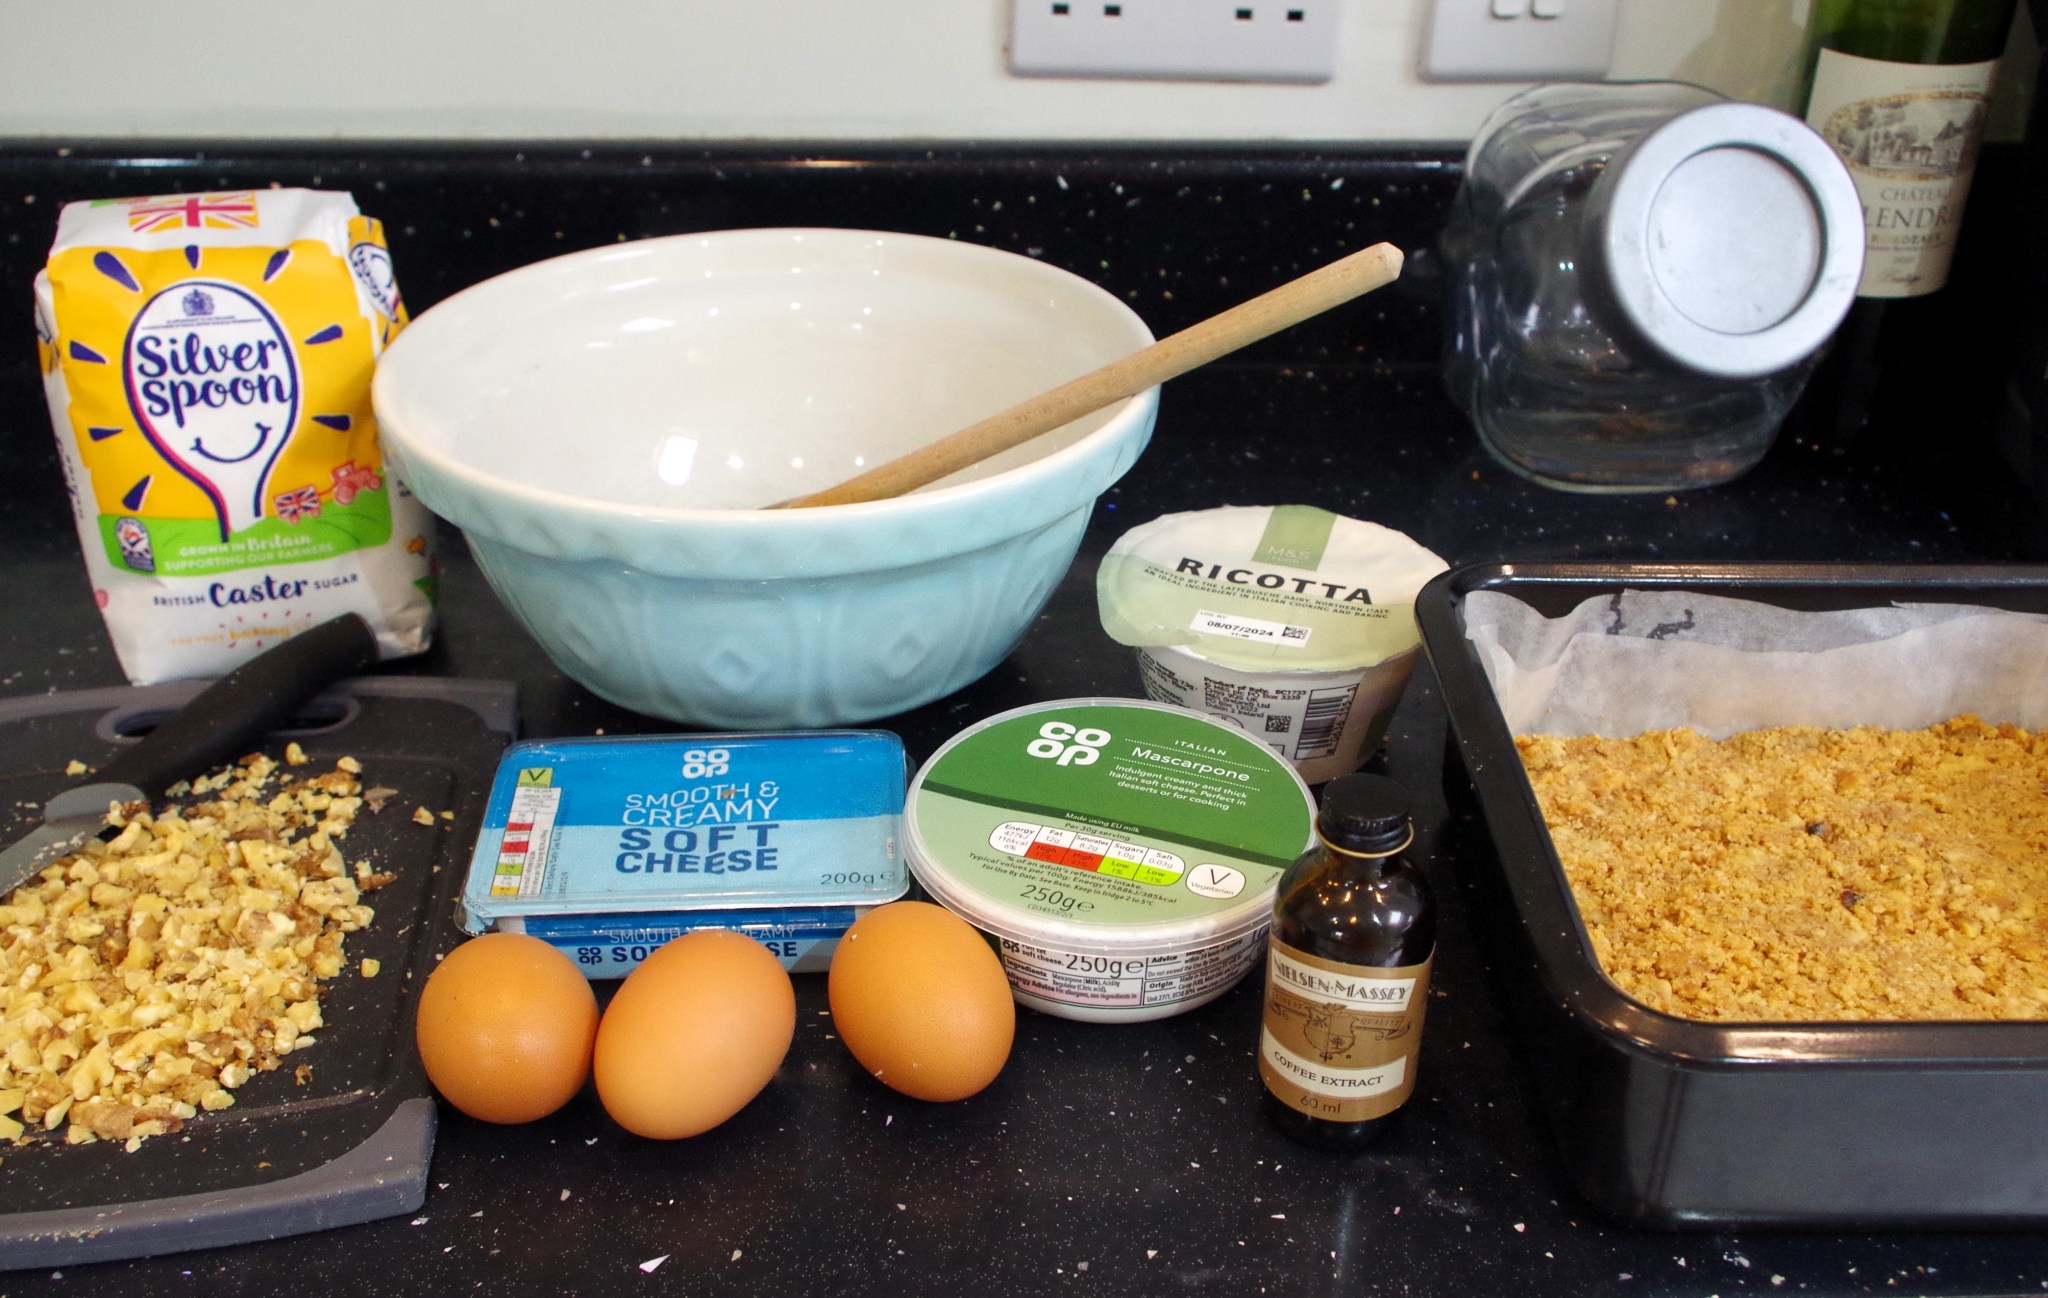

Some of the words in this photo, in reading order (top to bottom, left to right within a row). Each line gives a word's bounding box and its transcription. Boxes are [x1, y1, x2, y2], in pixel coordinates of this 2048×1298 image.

[136, 332, 278, 378] Silver
[247, 534, 312, 551] Britain
[247, 550, 275, 562] OUR
[1268, 546, 1311, 560] M&S
[1176, 557, 1373, 606] RICOTTA
[154, 595, 205, 606] BRITISH
[208, 575, 308, 608] Caster
[313, 573, 359, 590] SUGAR
[1143, 569, 1156, 577] AN
[1158, 574, 1182, 586] IDEAL
[1185, 583, 1236, 597] INGREDIENT
[1252, 595, 1286, 605] ITALIAN
[1289, 600, 1330, 612] COOKING
[1354, 611, 1390, 619] BAKING
[1202, 581, 1218, 589] THE
[1315, 600, 1363, 613] NORTHERN
[1207, 620, 1274, 637] 08/07/2024
[1204, 677, 1234, 688] Product
[1174, 740, 1227, 756] ITALIAN
[1131, 746, 1250, 782] Mascarpone
[1108, 770, 1138, 783] Italian
[1140, 776, 1159, 787] soft
[1160, 780, 1198, 796] cheese.
[1200, 789, 1234, 804] Perfect
[1237, 797, 1247, 807] in
[1115, 764, 1162, 782] Indulgent
[1164, 776, 1201, 789] creamy
[1202, 783, 1221, 793] and
[1223, 786, 1248, 799] thick
[625, 783, 749, 809] SMOOTH
[759, 781, 779, 797] &
[1117, 780, 1158, 794] desserts
[1160, 790, 1172, 798] or
[1172, 791, 1188, 800] for
[1189, 796, 1230, 811] cooking
[622, 798, 779, 829] CREAMY
[1004, 824, 1035, 835] Energy
[1065, 812, 1088, 822] Made
[1088, 817, 1109, 829] using
[1110, 820, 1123, 830] EU
[1123, 824, 1140, 834] milk
[619, 824, 779, 852] SOFT
[1049, 829, 1064, 837] Fat
[1064, 822, 1078, 831] Per
[1081, 826, 1097, 836] 30g
[1099, 830, 1131, 841] serving
[1045, 836, 1060, 844] 12g
[1075, 834, 1109, 847] Saturates
[1079, 843, 1099, 852] 8.2g
[1114, 842, 1145, 854] Sugars
[1036, 844, 1057, 854] High
[1072, 851, 1094, 861] High
[1117, 851, 1136, 860] 1.0g
[1156, 852, 1173, 861] Salt
[615, 848, 778, 875] CHEESE
[1110, 860, 1130, 869] Low
[1148, 858, 1173, 870] 0.03g
[969, 852, 1000, 865] Typical
[1001, 860, 1027, 872] values
[1028, 867, 1044, 877] per
[1073, 876, 1106, 889] Energy
[1016, 857, 1026, 865] of
[1070, 870, 1112, 884] reference
[1113, 880, 1143, 891] intake.
[1111, 867, 1124, 876] 1%
[1146, 868, 1166, 878] Low
[1211, 868, 1232, 885] V
[982, 863, 993, 871] For
[994, 866, 1008, 875] Use
[1008, 869, 1018, 878] By
[1040, 877, 1053, 885] See
[1074, 884, 1093, 895] Keep
[1102, 890, 1125, 902] fridge
[1190, 881, 1235, 896] Vegetarian
[609, 927, 681, 944] SMOOTH
[1022, 950, 1036, 959] soft
[1151, 955, 1177, 963] Advice
[1006, 958, 1047, 977] Ingredients
[1157, 969, 1165, 977] not
[1166, 967, 1184, 976] exceed
[1032, 979, 1055, 992] Advice
[1052, 972, 1082, 984] Mascarpone
[1052, 979, 1077, 990] Regulator
[1149, 981, 1173, 989] Origin
[1274, 1051, 1317, 1081] COFFEE
[1320, 1075, 1384, 1088] EXTRACT
[1300, 1095, 1318, 1109] 60
[1322, 1102, 1342, 1114] ml
